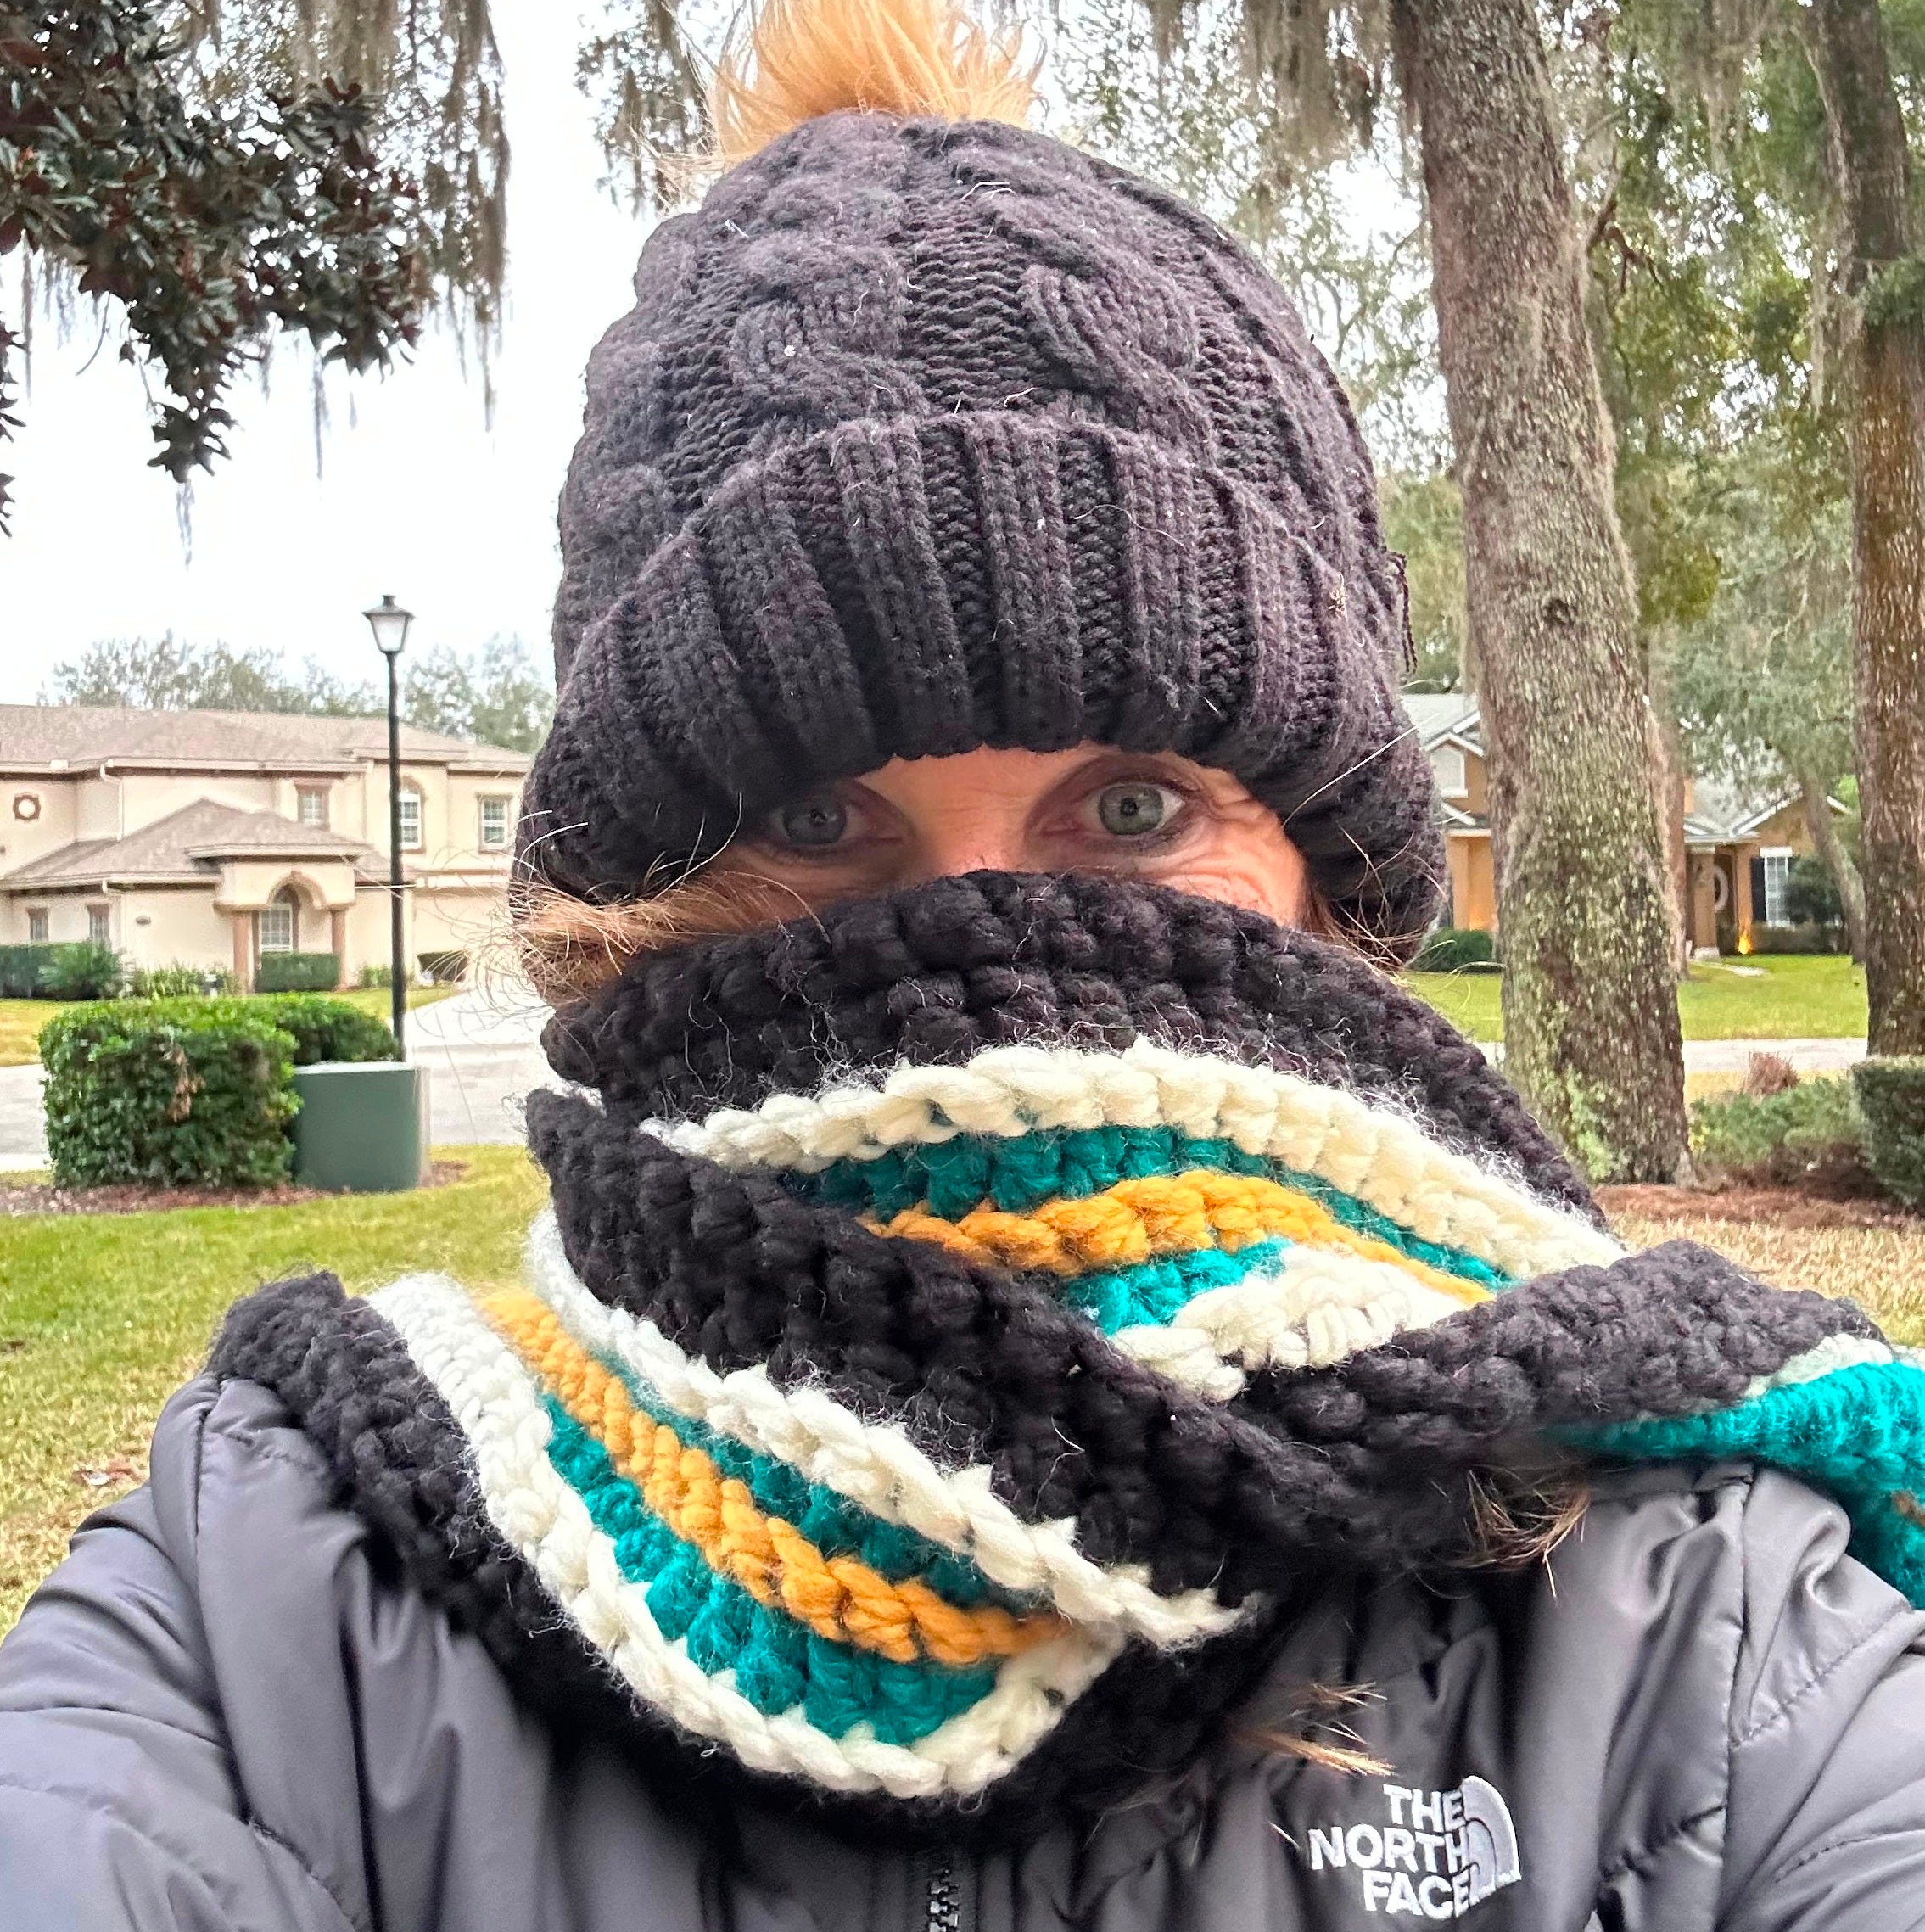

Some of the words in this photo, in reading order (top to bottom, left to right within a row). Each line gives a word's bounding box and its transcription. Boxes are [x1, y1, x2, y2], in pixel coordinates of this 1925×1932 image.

[1383, 1784, 1466, 1832] THE
[1308, 1823, 1469, 1873] NORTH
[1363, 1869, 1470, 1919] FACE
